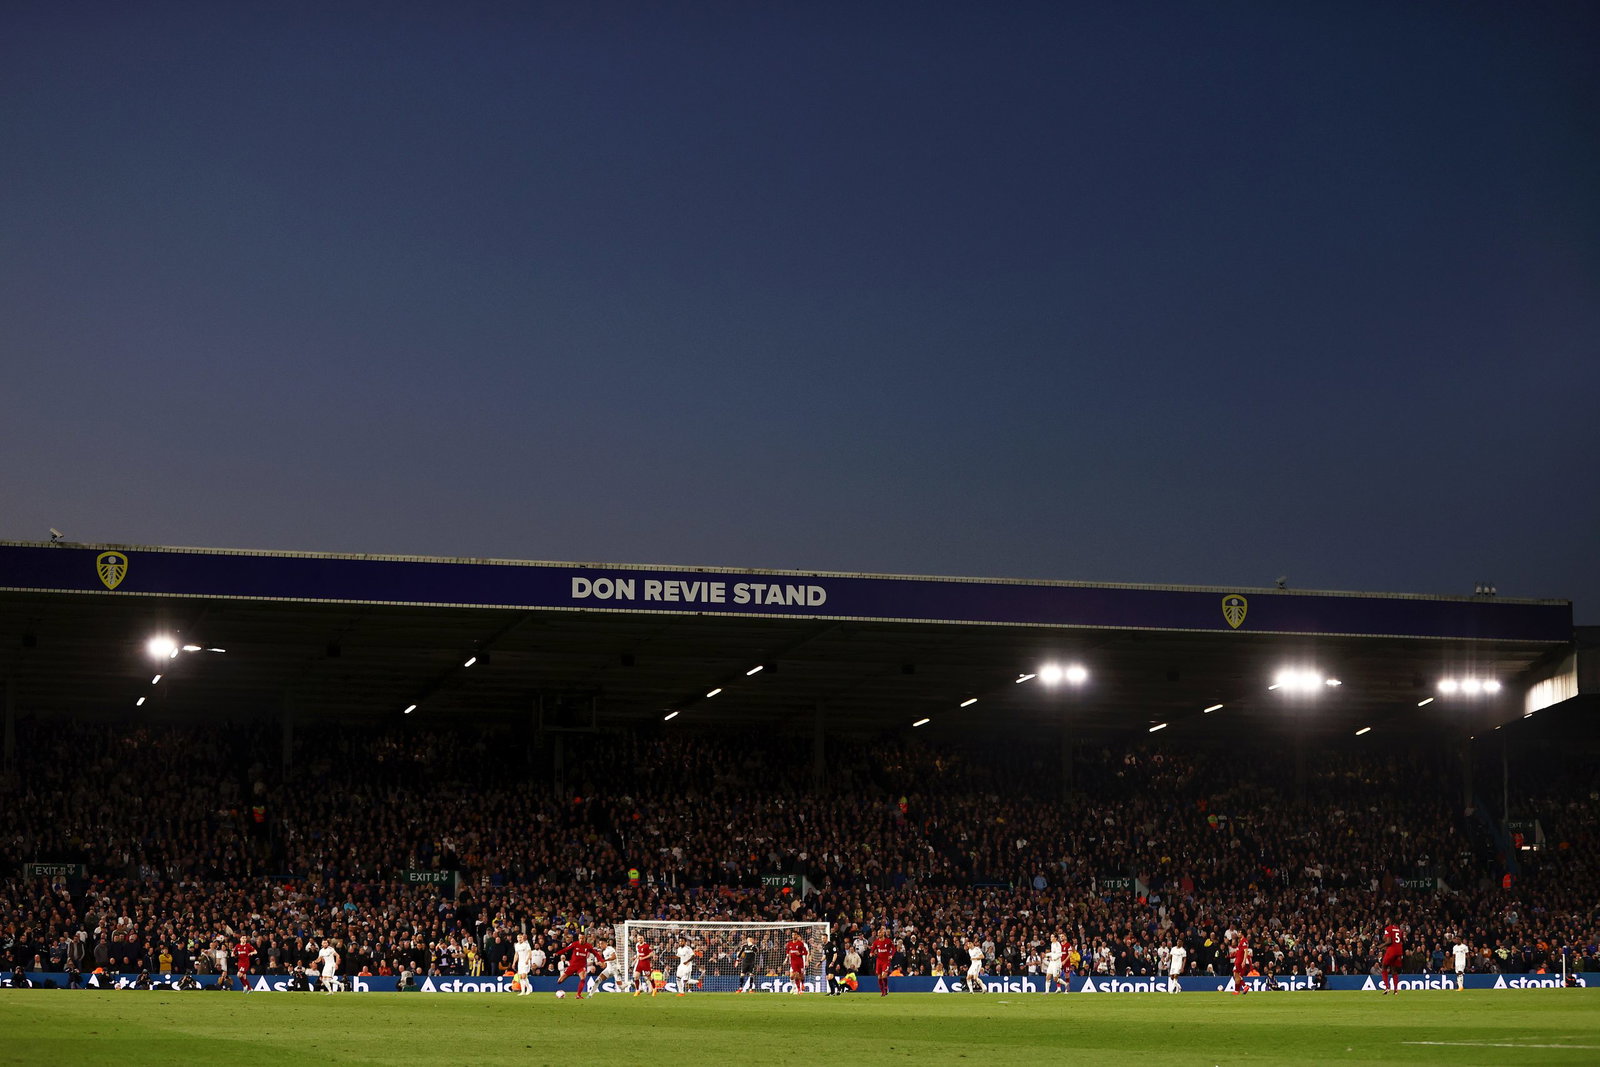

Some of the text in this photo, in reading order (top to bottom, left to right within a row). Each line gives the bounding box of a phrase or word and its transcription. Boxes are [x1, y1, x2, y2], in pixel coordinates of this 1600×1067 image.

[571, 577, 827, 607] DON REVIE STAND
[35, 866, 58, 875] EXIT
[410, 873, 431, 882] EXIT
[1395, 932, 1400, 943] 5
[932, 976, 1036, 993] Asnish
